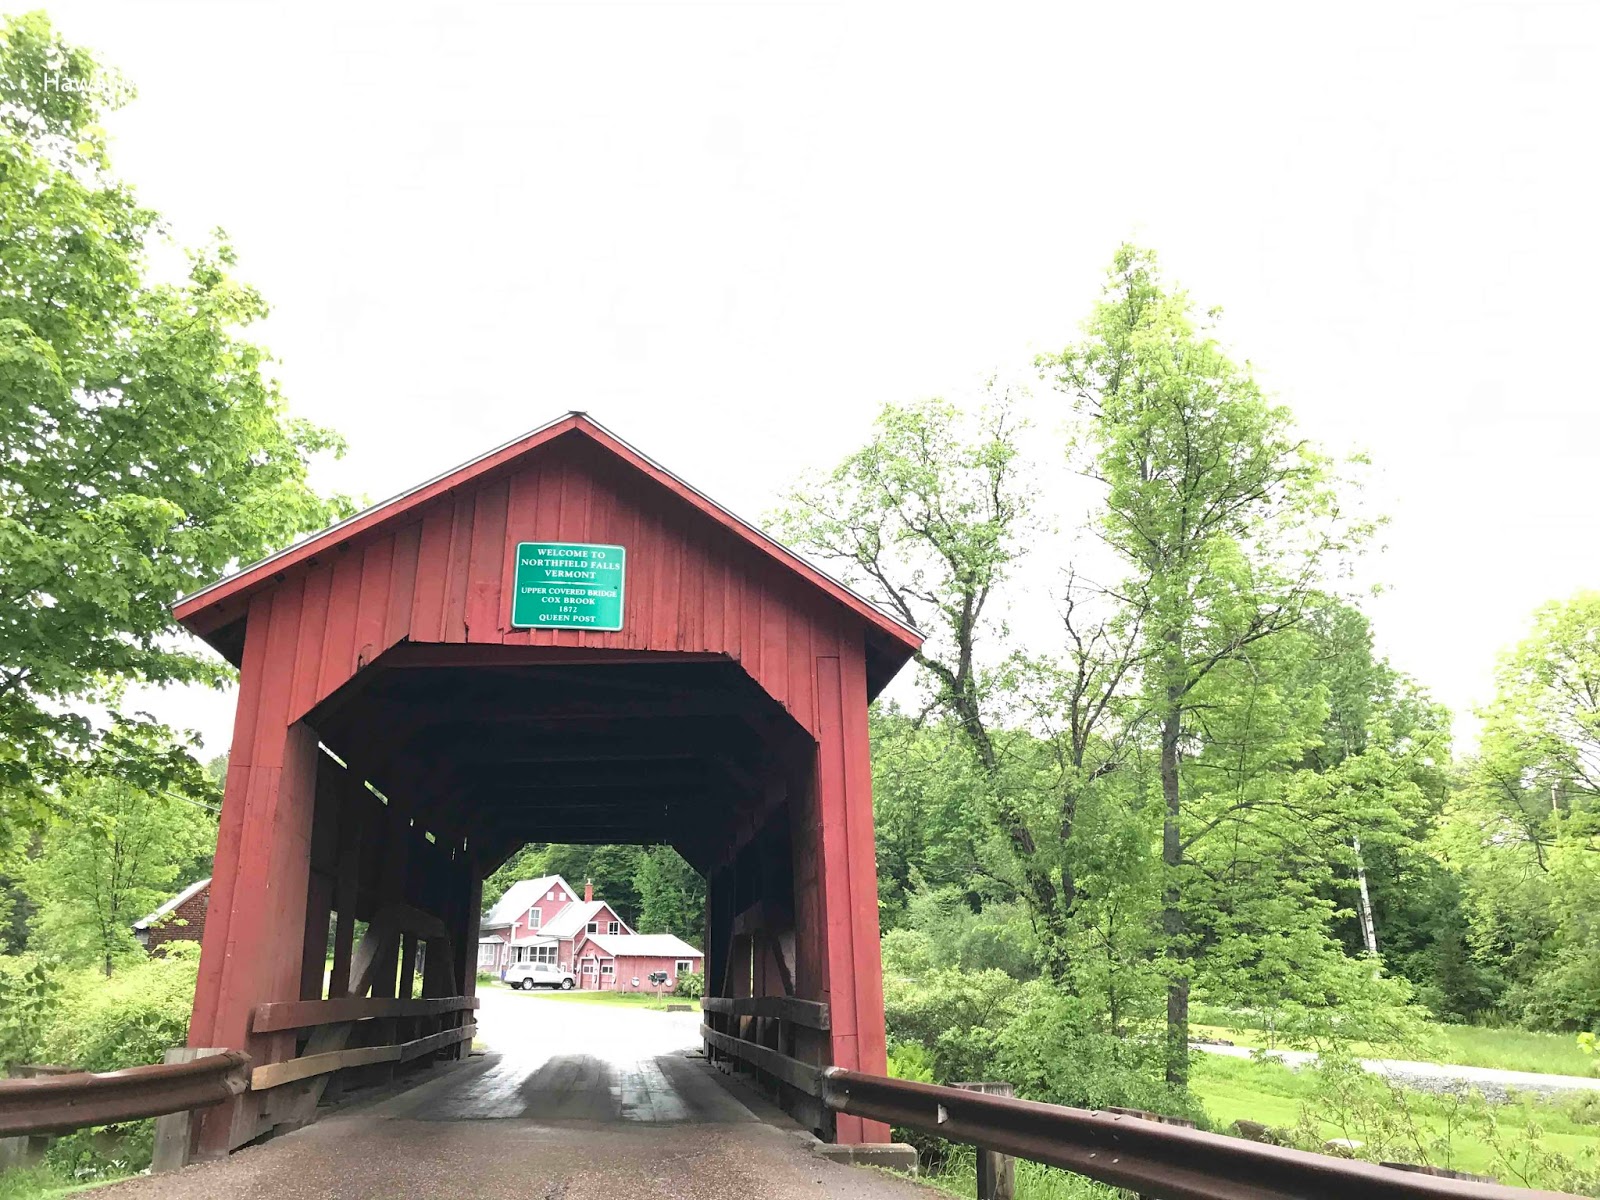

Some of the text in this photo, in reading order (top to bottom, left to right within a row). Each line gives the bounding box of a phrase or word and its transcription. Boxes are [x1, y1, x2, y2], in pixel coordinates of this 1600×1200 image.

[537, 548, 606, 559] WELCOME TO
[521, 558, 620, 570] NORTHFIELD FALLS
[545, 569, 596, 579] VERMONT
[521, 587, 618, 598] UPPER COVERED BRIDGE
[541, 596, 596, 605] COX BROOK
[539, 613, 596, 623] QUEEN POST
